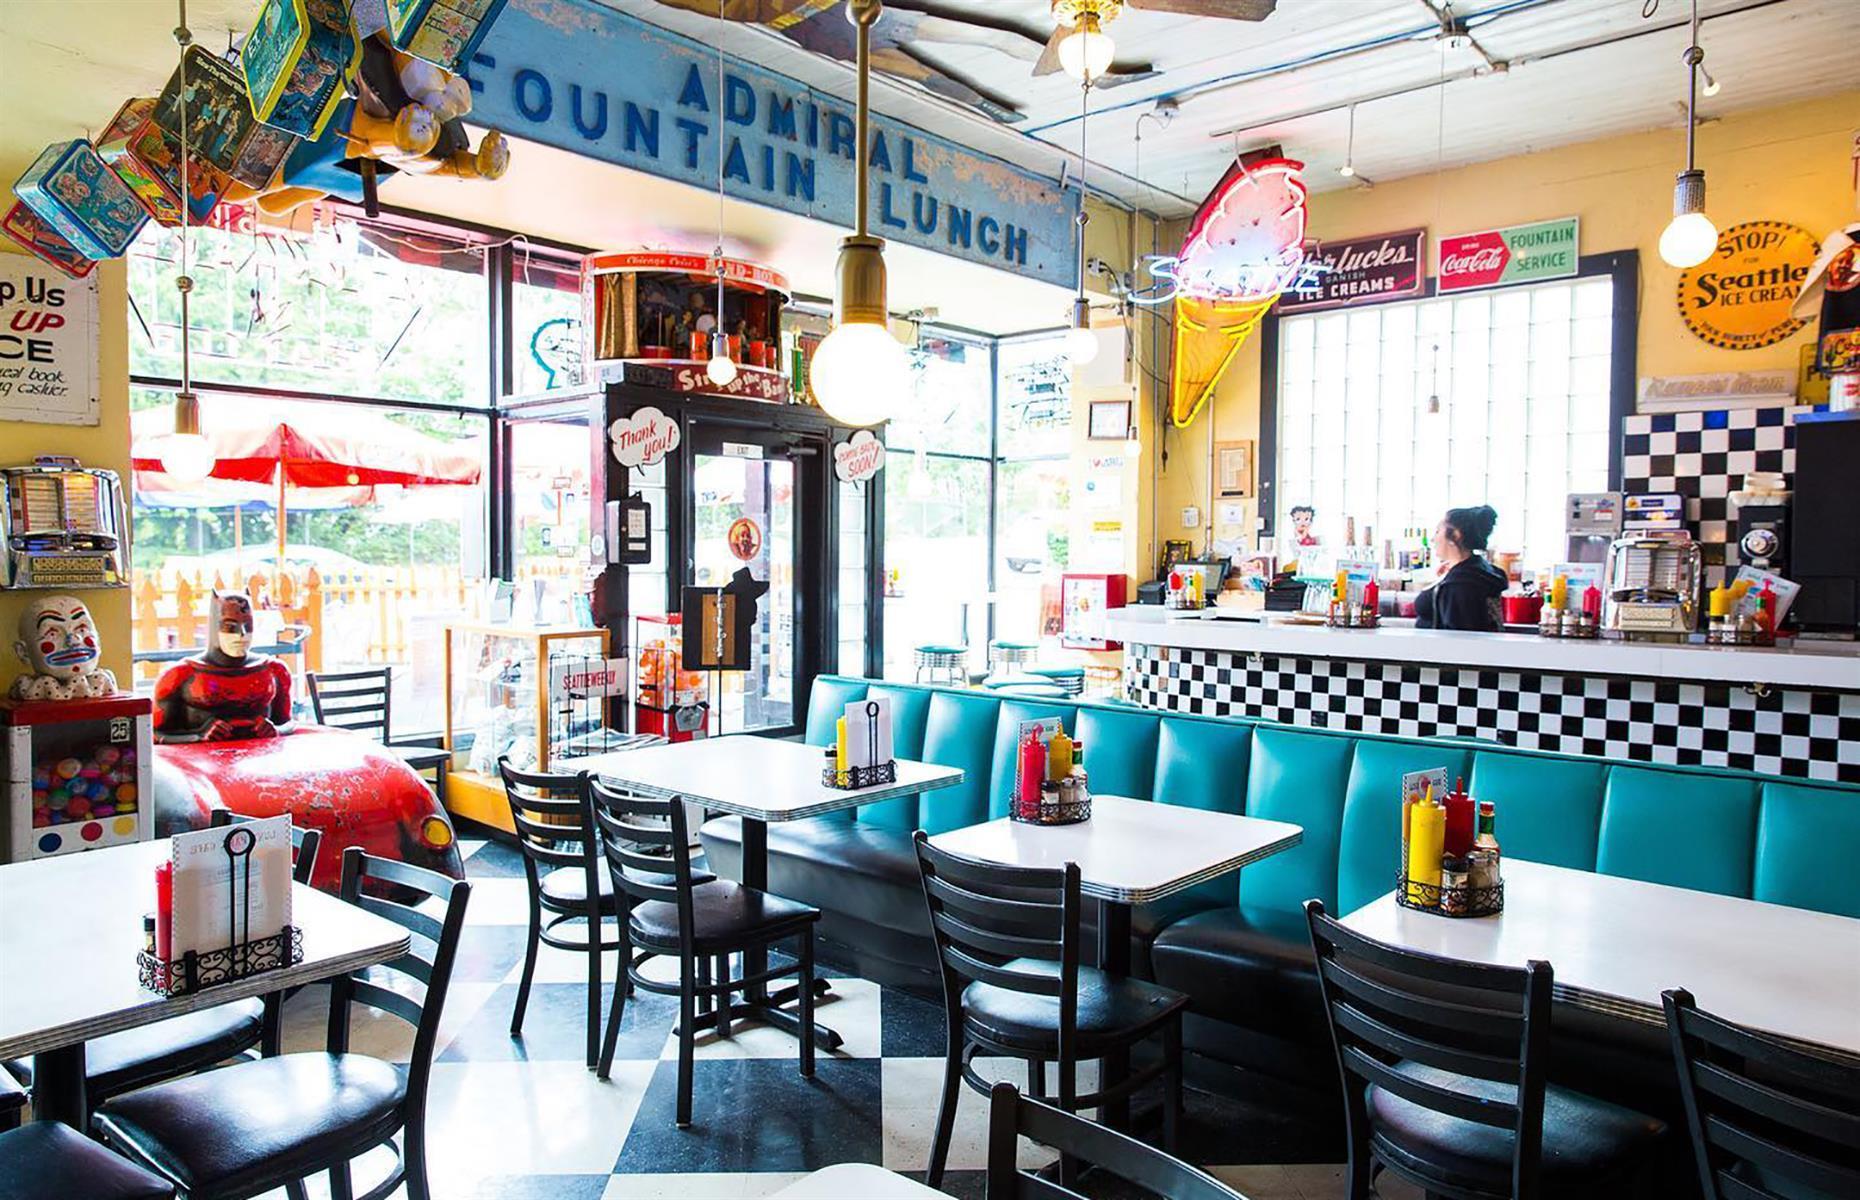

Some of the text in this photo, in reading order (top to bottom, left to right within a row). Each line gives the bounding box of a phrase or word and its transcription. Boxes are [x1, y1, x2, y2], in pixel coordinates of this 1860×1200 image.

[678, 62, 928, 184] ADMIRAL
[467, 52, 1028, 266] FOUNTAIN LUNCH
[1510, 227, 1574, 249] FOUNTAIN
[1717, 231, 1787, 259] STOP!
[1516, 251, 1566, 272] SERVICE
[1325, 271, 1366, 284] DANISH
[1331, 276, 1395, 298] CREAMS
[1691, 263, 1809, 309] Seattle
[26, 276, 66, 307] Us
[1720, 291, 1744, 307] ICE
[10, 309, 66, 334] UP
[727, 377, 744, 394] up
[619, 418, 658, 451] Thank
[642, 425, 675, 461] you!
[736, 445, 750, 455] EXIT
[111, 722, 128, 740] 25
